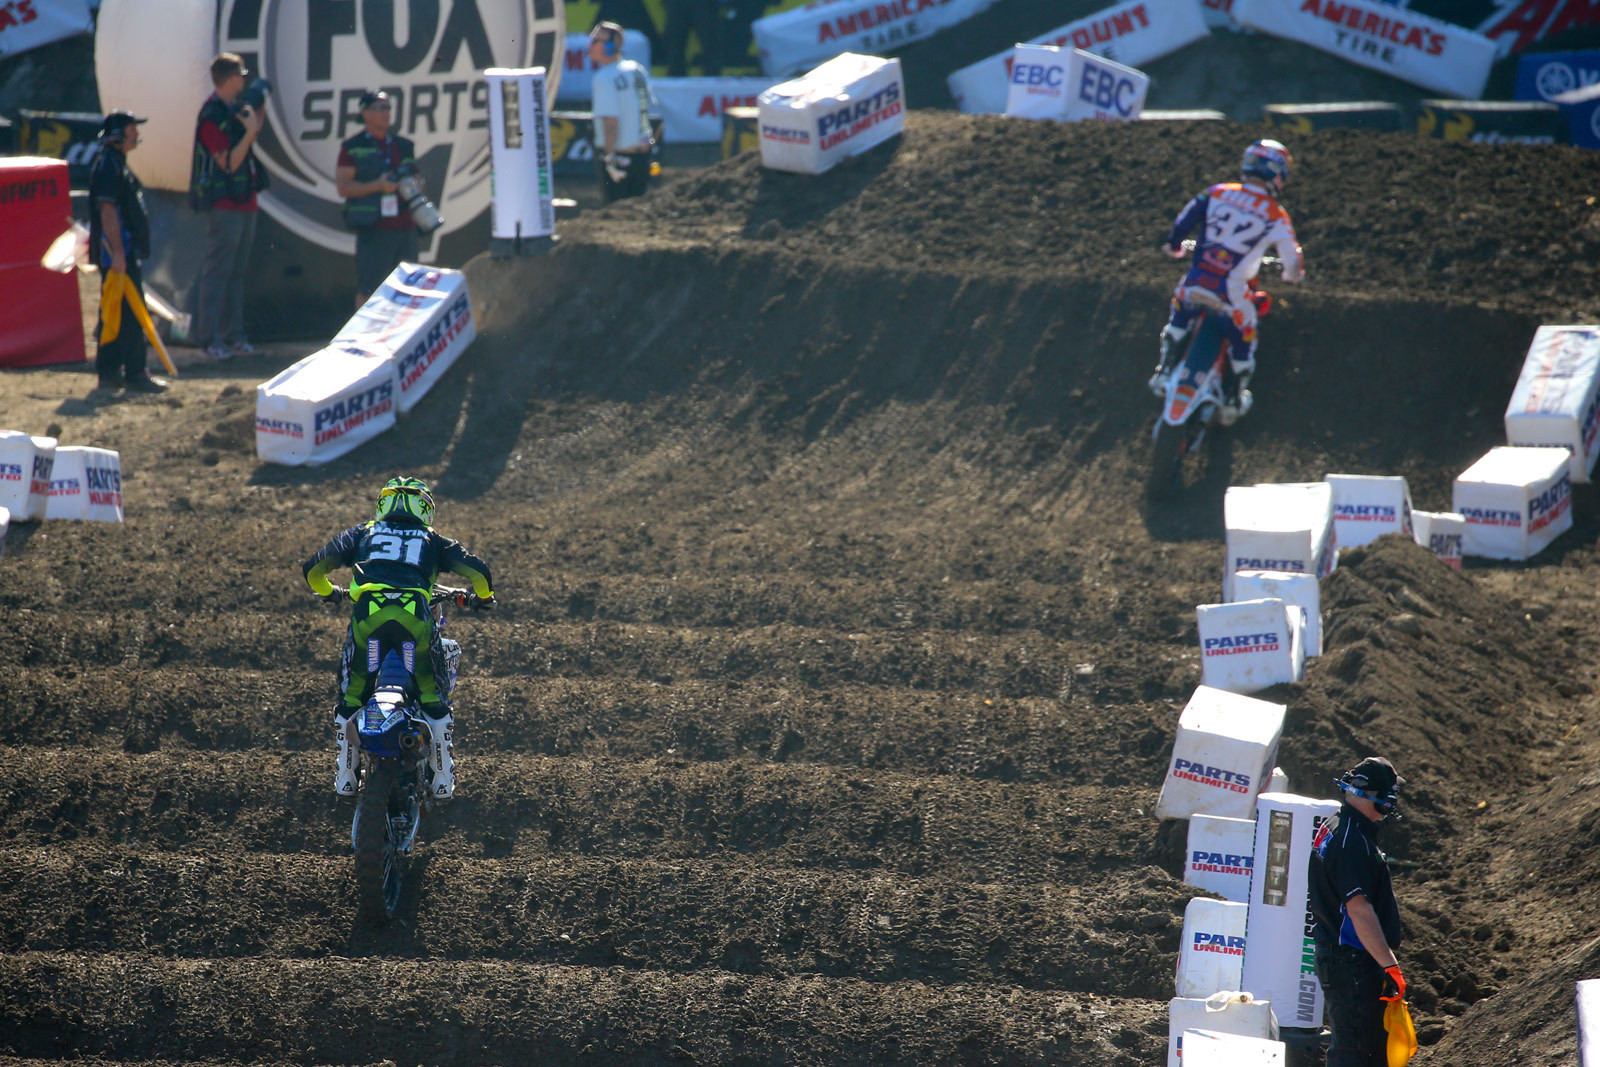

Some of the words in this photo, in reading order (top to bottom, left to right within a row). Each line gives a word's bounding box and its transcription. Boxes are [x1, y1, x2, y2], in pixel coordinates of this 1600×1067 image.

[307, 0, 497, 81] FOX
[1336, 29, 1397, 64] TIRE
[1013, 64, 1064, 87] EBC
[1079, 62, 1134, 117] EBC
[301, 80, 490, 140] SPORTS
[818, 81, 899, 137] PARTS
[819, 102, 902, 150] UNLIMITED
[398, 291, 468, 380] PARTS
[401, 311, 471, 392] UNLIMITED
[315, 380, 393, 432] PARTS
[315, 400, 393, 446] UNLIMITED
[1334, 504, 1396, 515] PARTS
[1460, 507, 1521, 521] PARTS
[369, 534, 423, 565] 31
[1236, 557, 1304, 570] PARTS
[1205, 633, 1278, 649] PARTS
[1206, 644, 1279, 656] UNLIMITED
[1173, 769, 1249, 794] UNLIMITED
[1174, 758, 1250, 786] PARTS
[1192, 863, 1250, 876] UNLIMIT
[1193, 851, 1253, 868] PART
[1194, 932, 1246, 948] PAR
